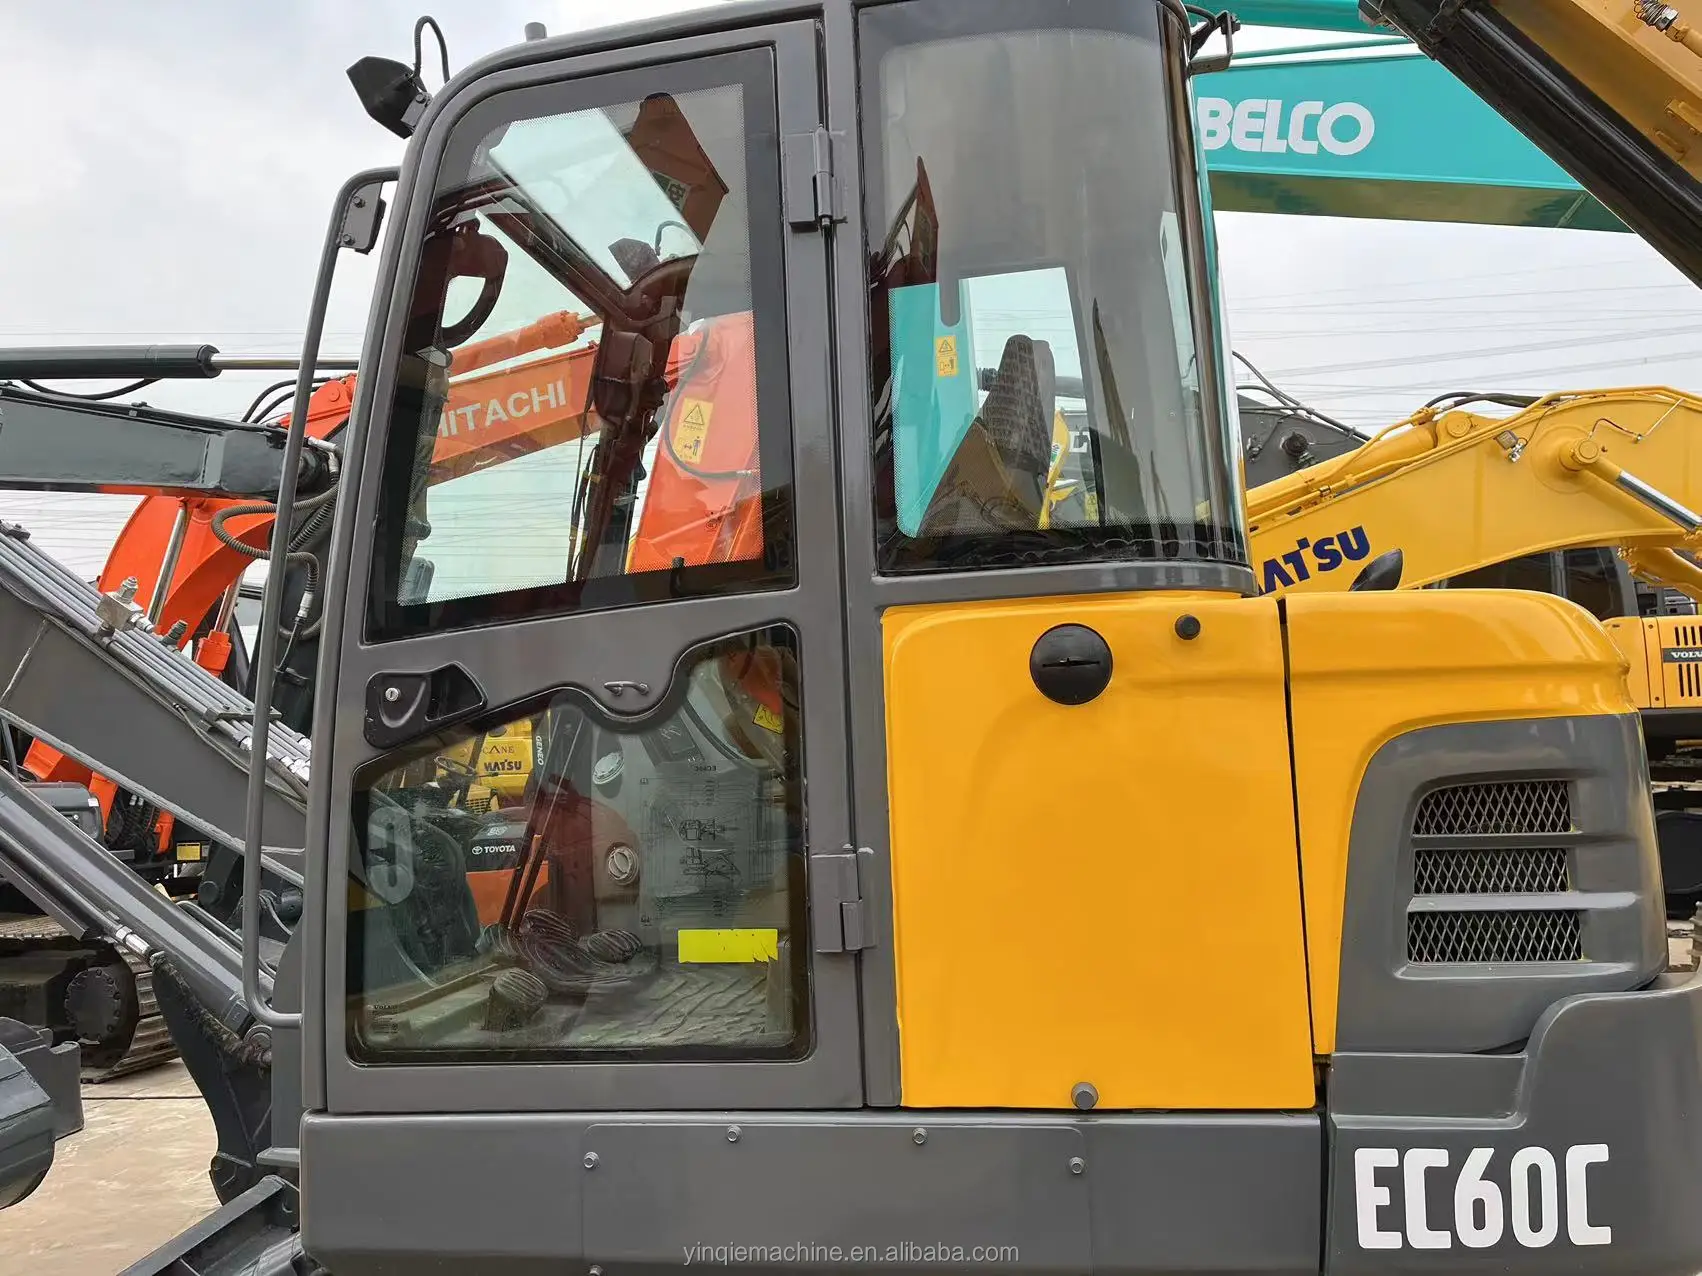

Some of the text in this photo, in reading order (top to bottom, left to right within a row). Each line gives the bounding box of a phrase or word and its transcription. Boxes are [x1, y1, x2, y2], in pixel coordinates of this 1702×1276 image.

[1197, 97, 1375, 155] BELCO
[1259, 525, 1370, 596] ATSU
[536, 735, 544, 765] GENEO
[484, 845, 516, 853] TOYOTA
[1355, 1144, 1612, 1249] EC60C
